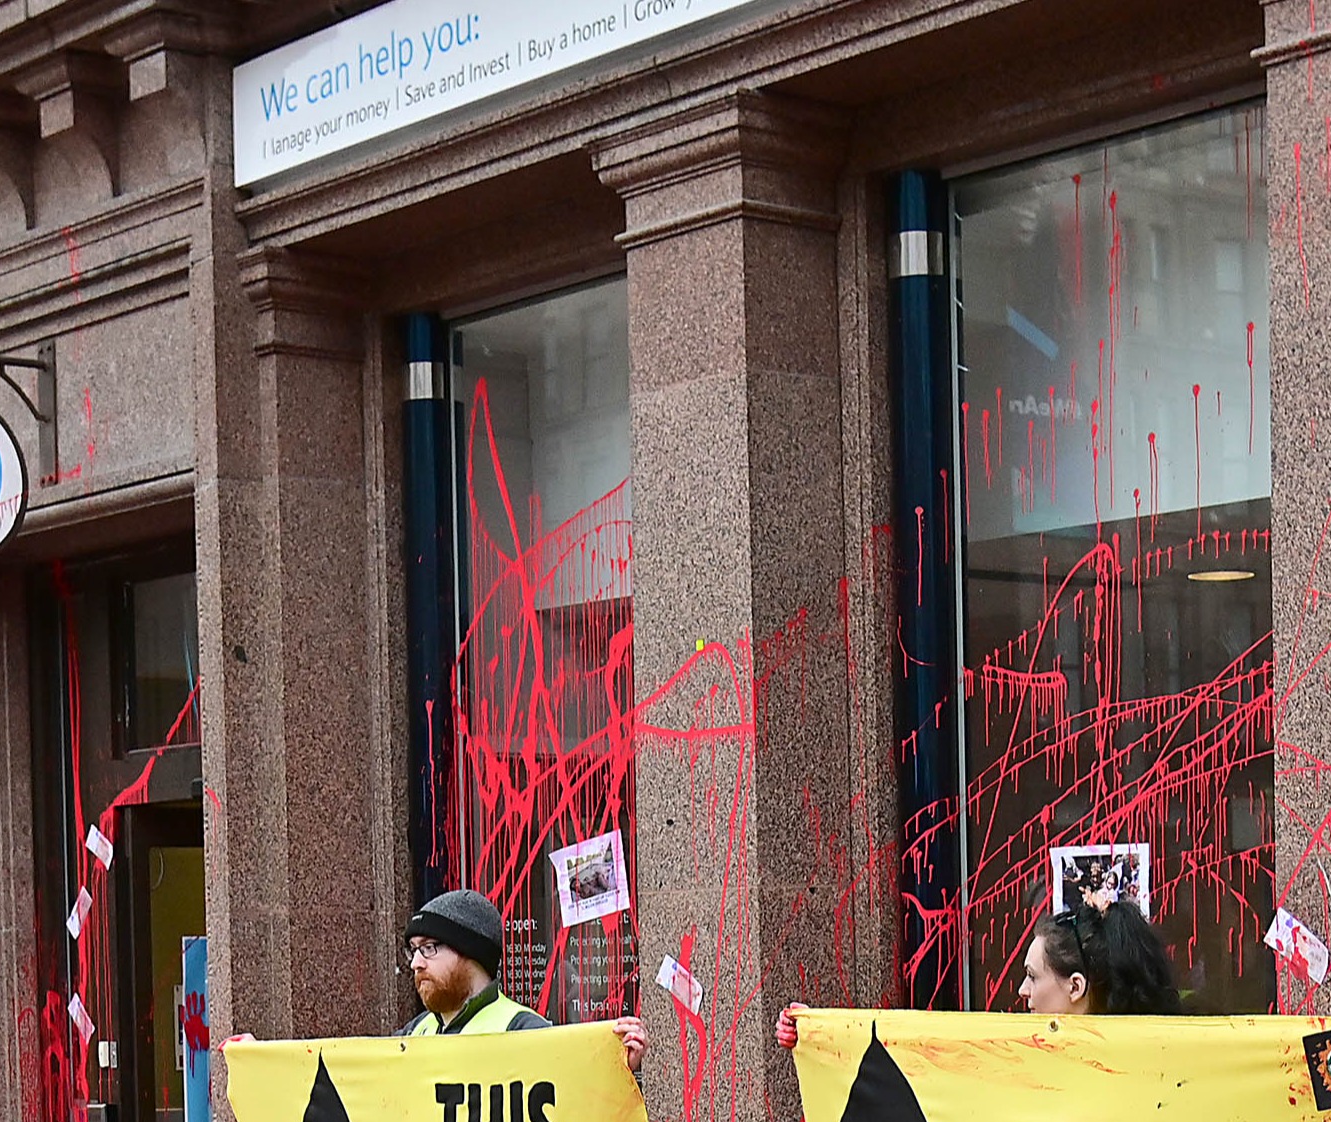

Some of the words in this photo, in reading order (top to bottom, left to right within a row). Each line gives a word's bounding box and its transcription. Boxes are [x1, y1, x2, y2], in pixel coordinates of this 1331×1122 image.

[260, 78, 298, 122] We
[305, 61, 350, 103] can
[358, 30, 414, 84] help
[422, 13, 480, 70] you:
[315, 117, 344, 145] your
[346, 98, 391, 128] money
[404, 83, 436, 107] Save
[438, 64, 467, 93] and
[469, 53, 511, 84] Invest
[528, 38, 556, 61] Buy
[559, 33, 568, 50] a
[572, 15, 617, 44] home
[524, 943, 547, 954] Mnday
[524, 956, 548, 967] Tesday
